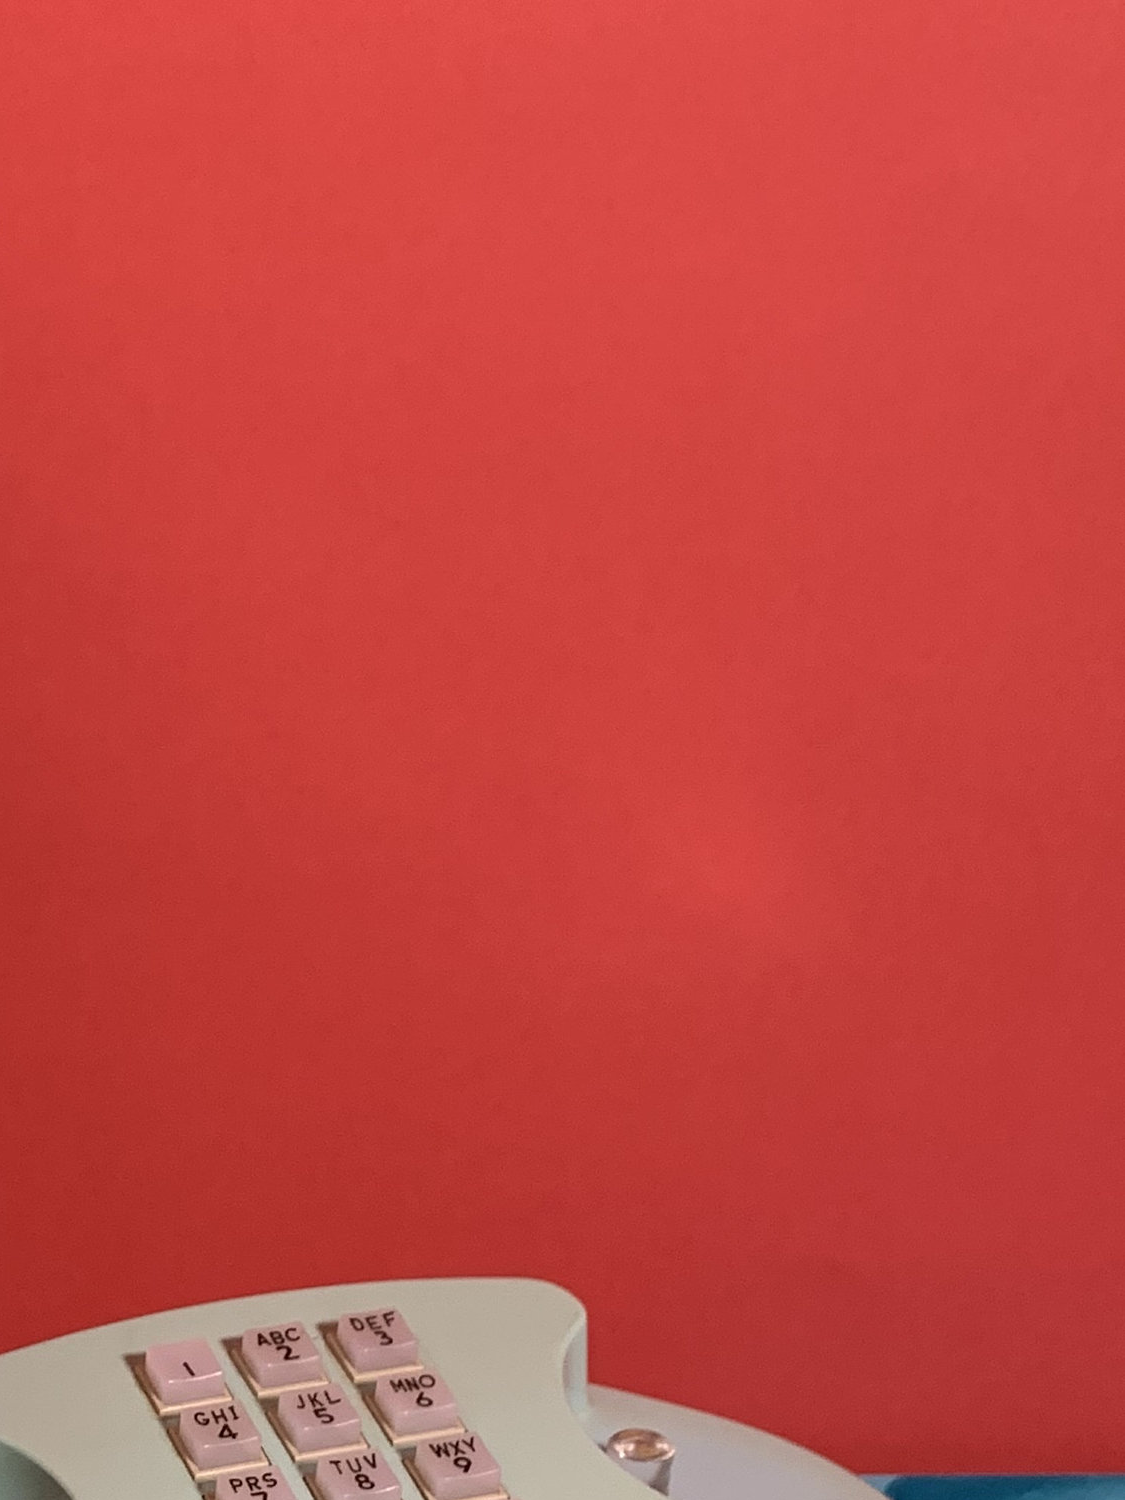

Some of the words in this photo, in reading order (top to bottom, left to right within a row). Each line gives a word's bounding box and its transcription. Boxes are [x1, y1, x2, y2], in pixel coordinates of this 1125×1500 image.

[349, 1311, 395, 1331] DEF
[257, 1327, 301, 1346] ABC
[374, 1330, 393, 1346] 3
[276, 1346, 300, 1361] 2
[389, 1374, 436, 1393] MNO
[296, 1390, 341, 1409] JKL
[416, 1391, 433, 1408] 6
[193, 1405, 240, 1426] GHI
[312, 1408, 335, 1424] 5
[218, 1424, 239, 1440] 4
[428, 1436, 476, 1458] WXY
[329, 1453, 378, 1475] TUV
[453, 1456, 472, 1474] 9
[228, 1472, 278, 1493] PRS
[354, 1473, 375, 1490] 8
